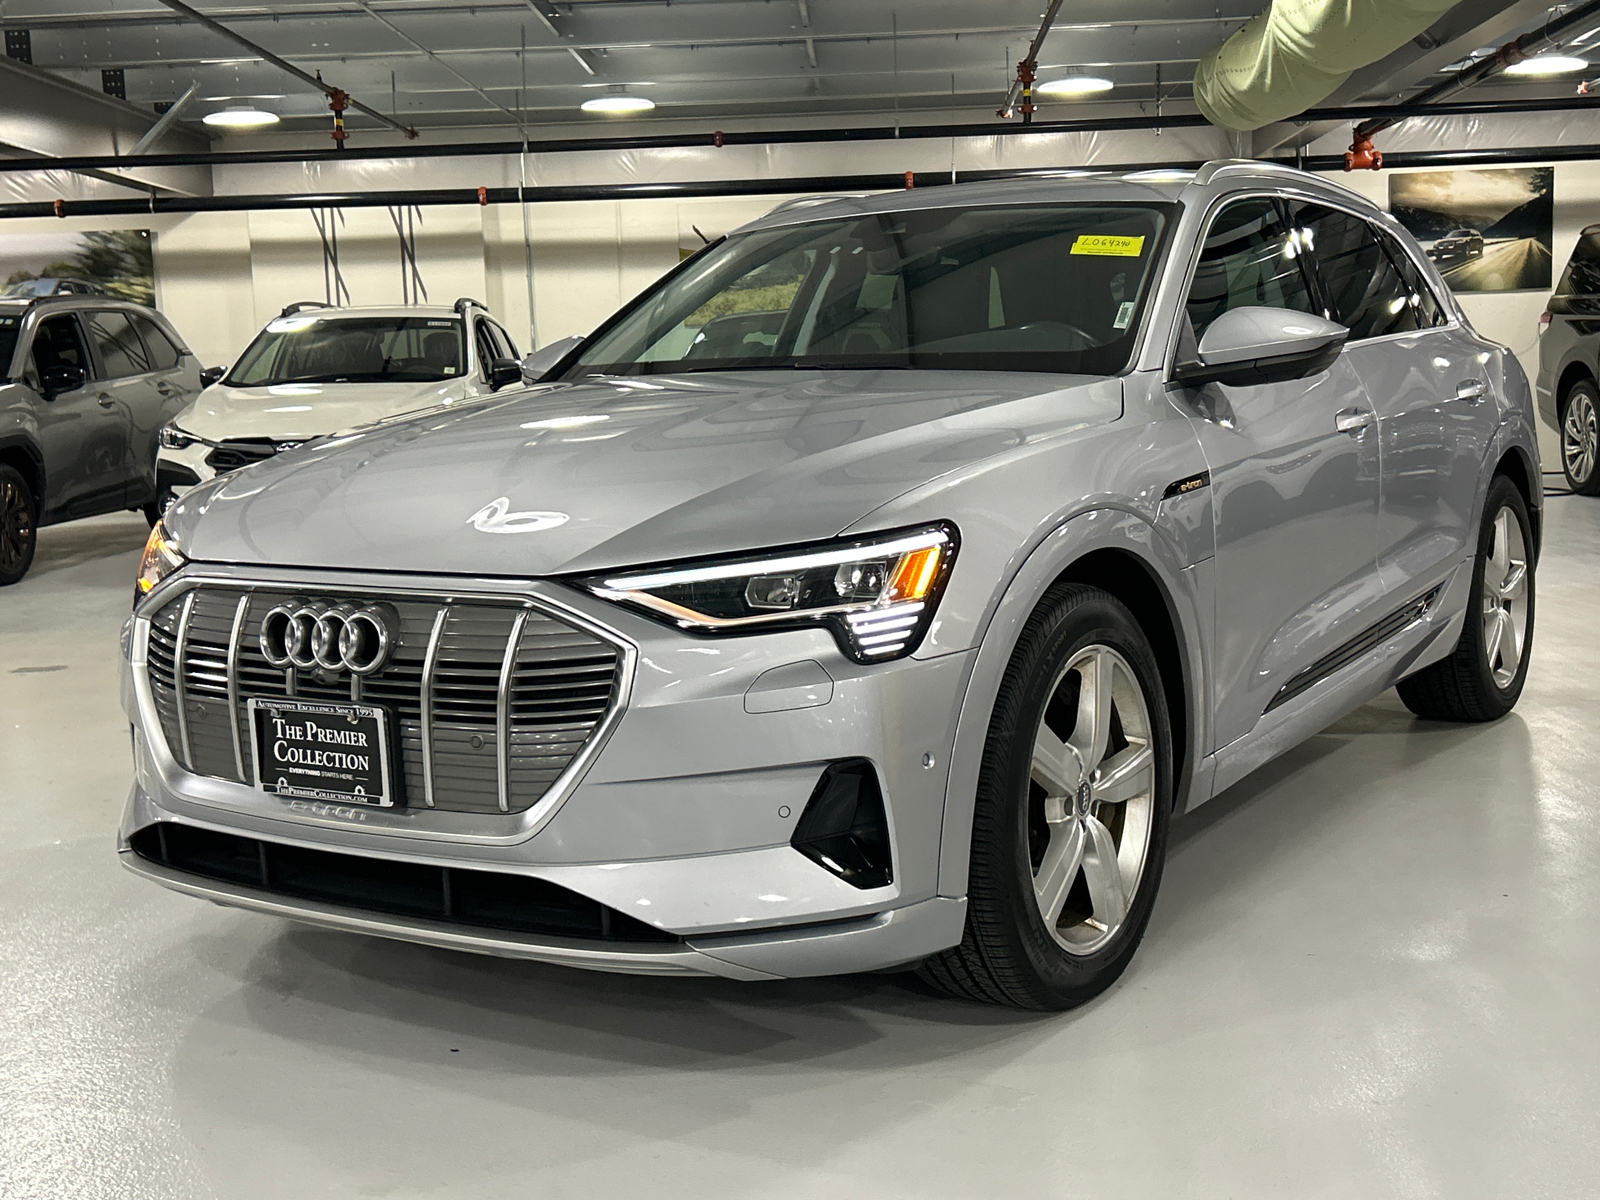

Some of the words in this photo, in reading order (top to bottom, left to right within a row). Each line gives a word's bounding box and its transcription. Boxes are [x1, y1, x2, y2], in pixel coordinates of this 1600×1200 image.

[1181, 479, 1203, 492] e-tron
[272, 718, 305, 740] THE
[305, 721, 368, 747] PREMIER
[273, 740, 369, 771] COLLECTION
[289, 767, 320, 777] EVERYTHING
